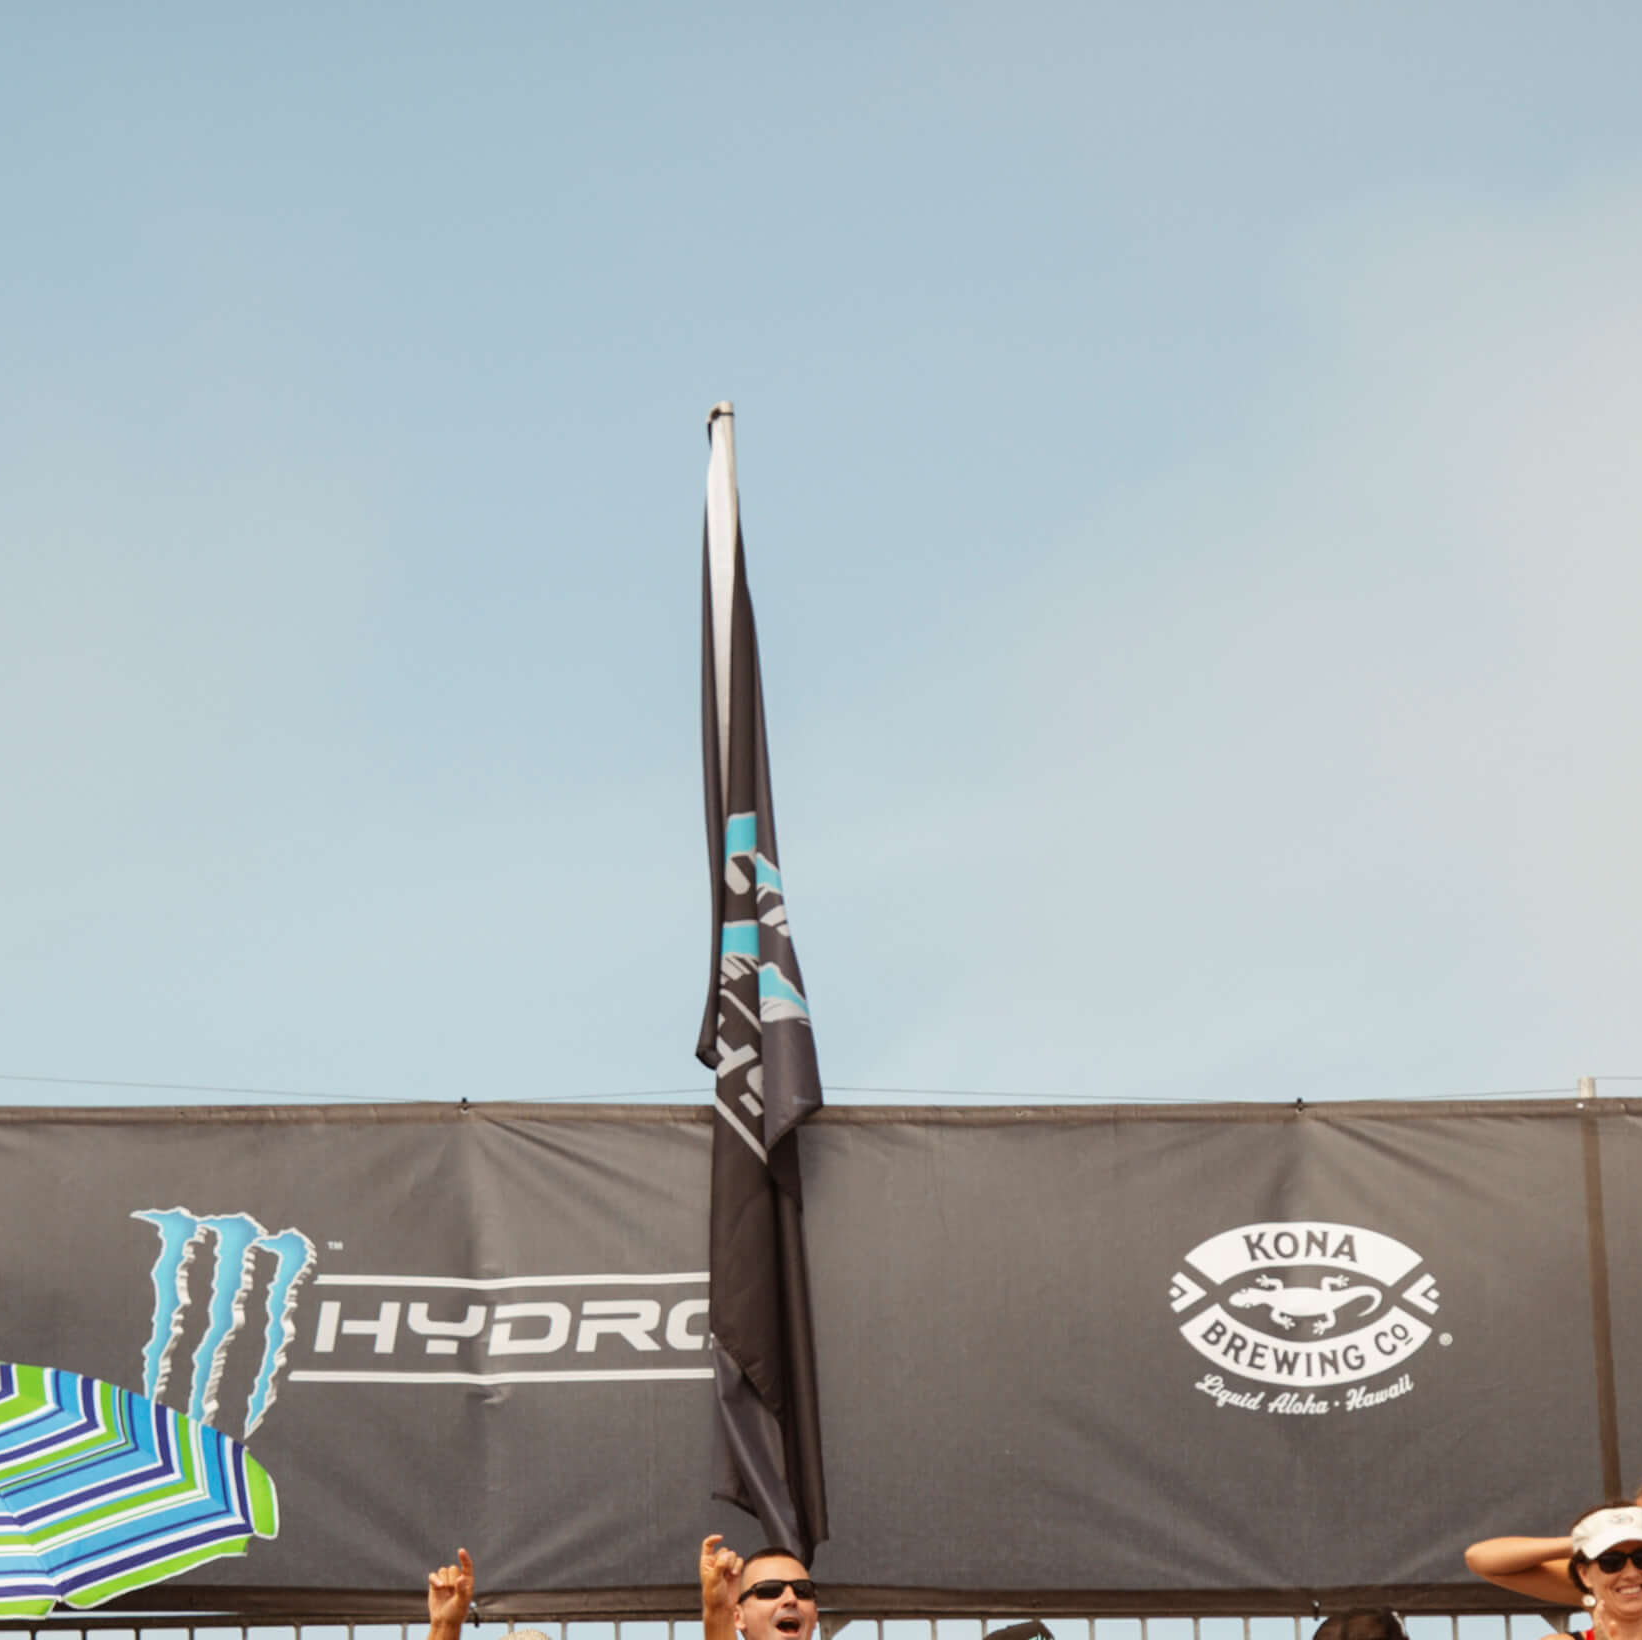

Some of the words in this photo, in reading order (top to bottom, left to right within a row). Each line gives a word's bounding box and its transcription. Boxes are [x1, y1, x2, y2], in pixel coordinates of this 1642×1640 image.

[1243, 1229, 1358, 1264] KONA
[1200, 1318, 1366, 1378] BREWING
[1195, 1373, 1262, 1408] Liquid
[1267, 1393, 1329, 1415] Aloha
[1345, 1373, 1415, 1412] Hawaii
